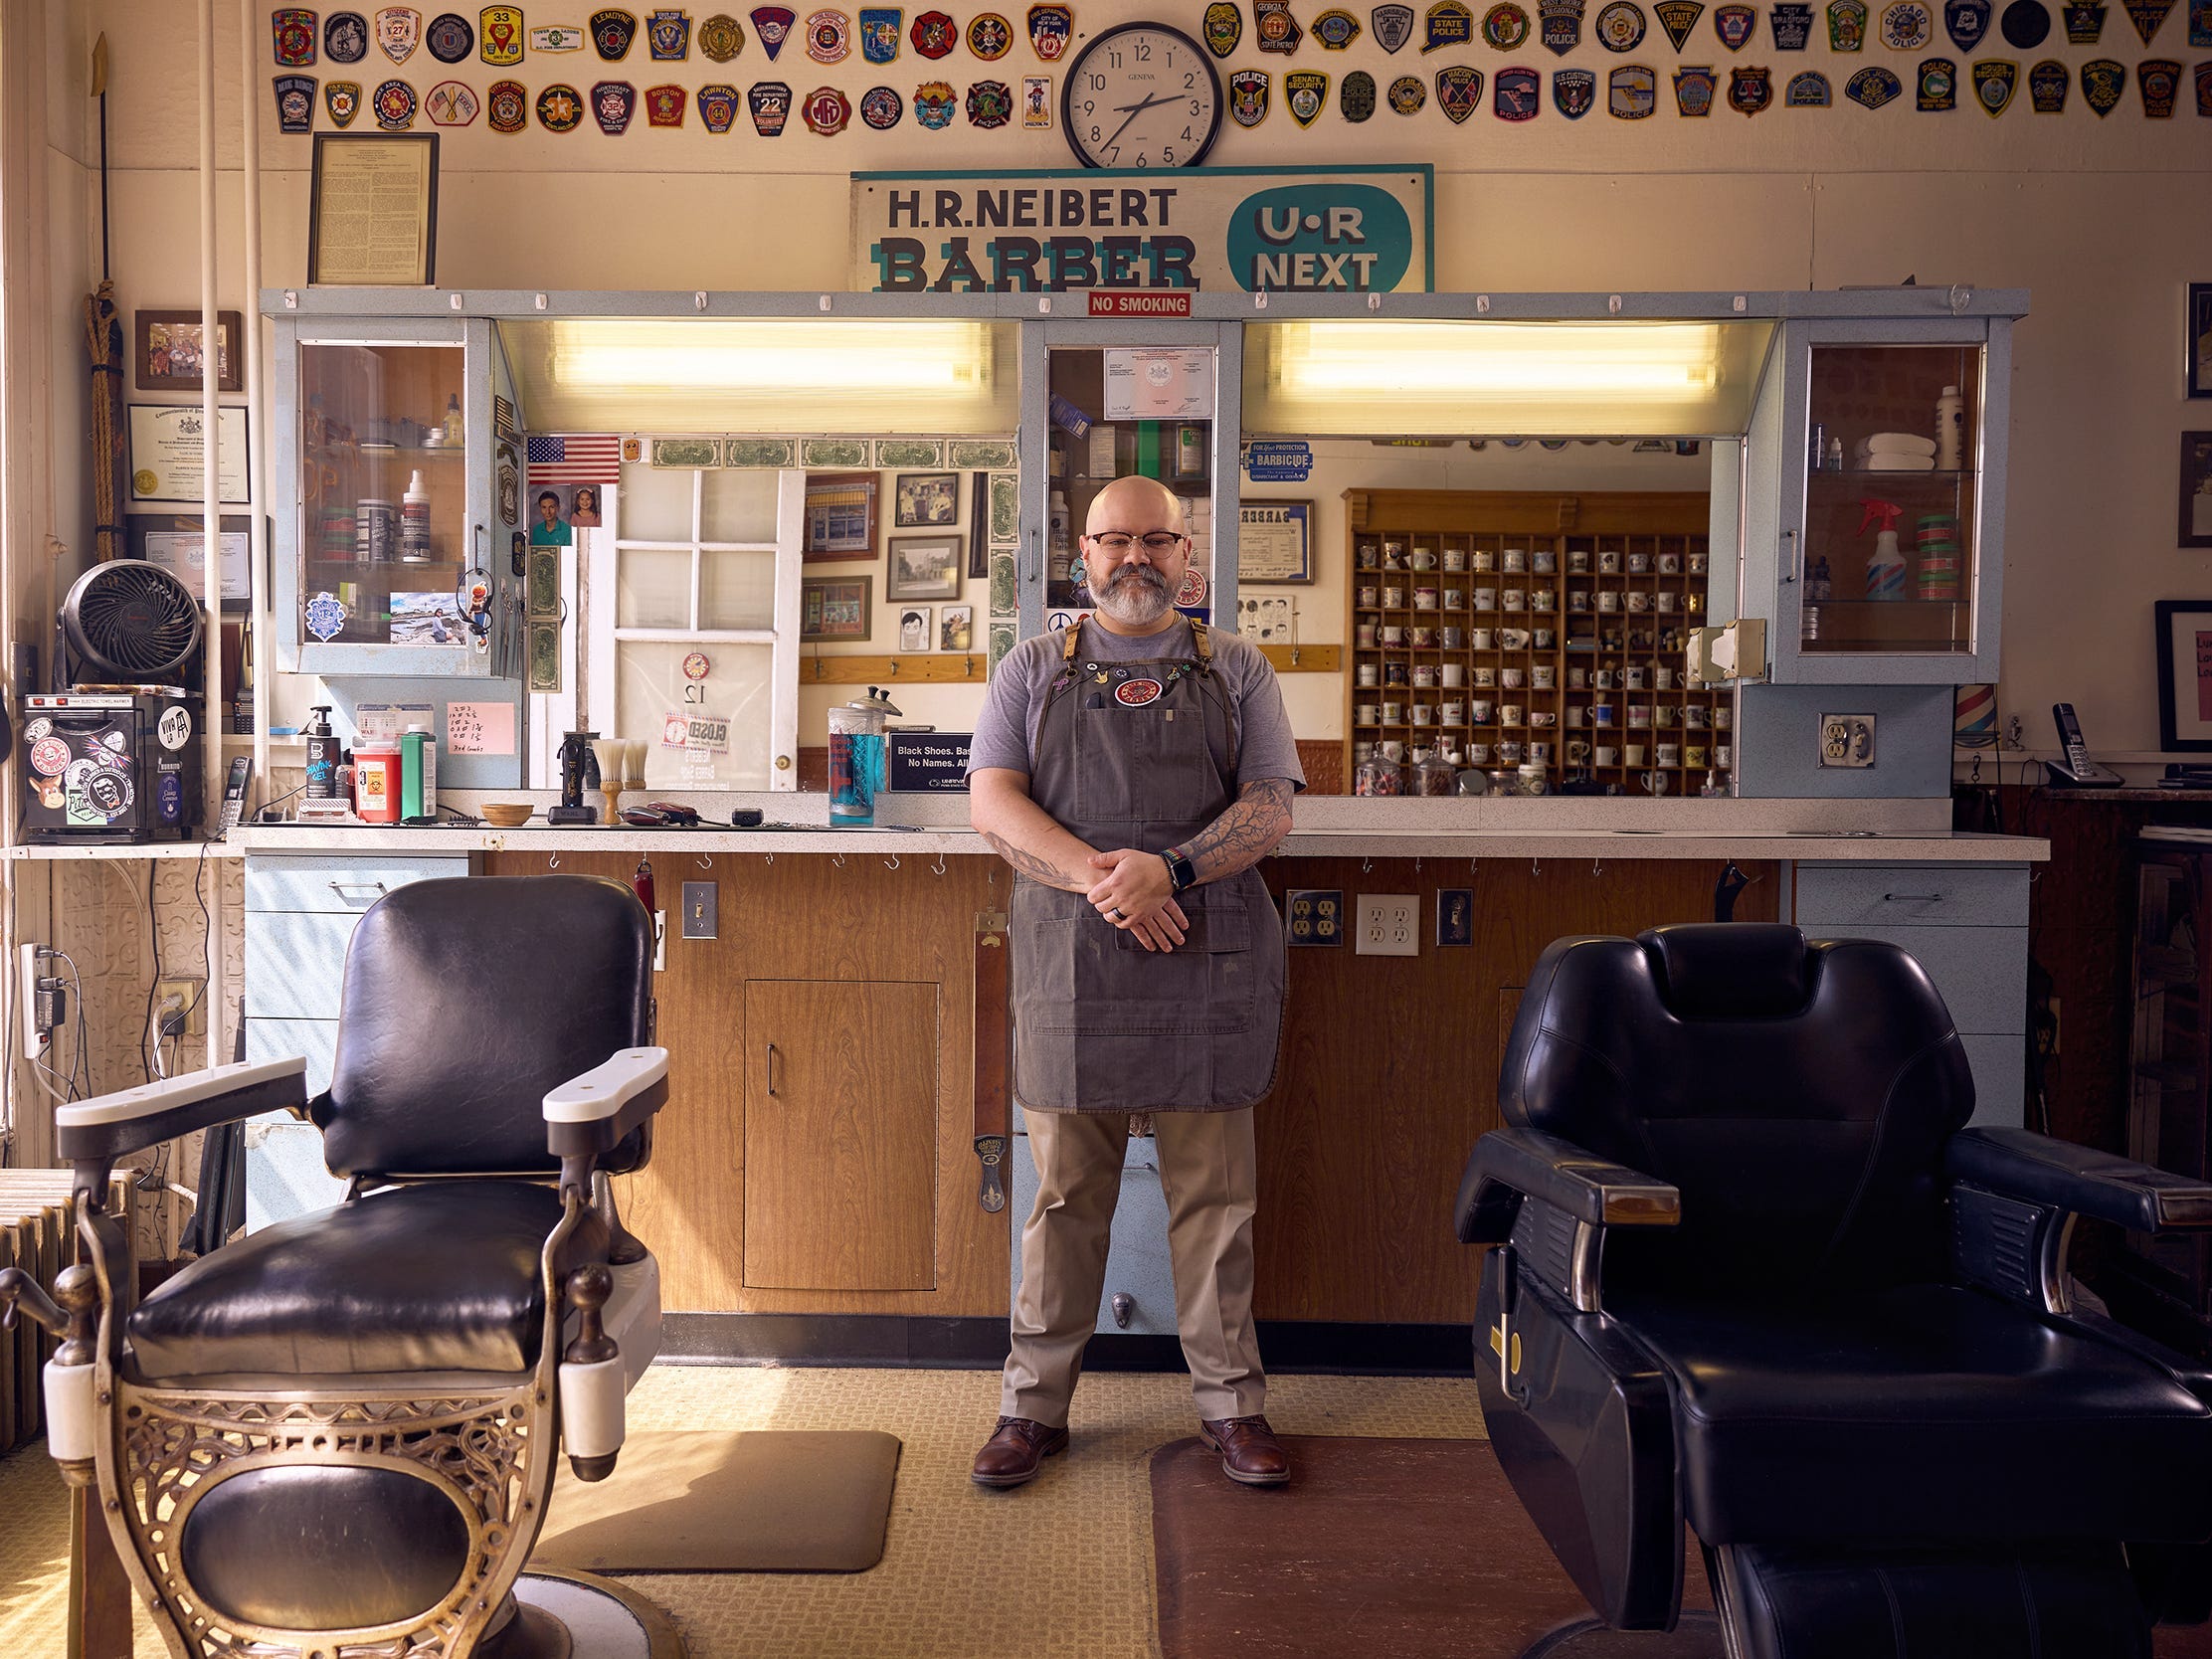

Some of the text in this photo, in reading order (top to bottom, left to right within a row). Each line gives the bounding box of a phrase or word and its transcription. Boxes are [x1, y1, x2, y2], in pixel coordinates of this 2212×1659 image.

[1257, 3, 1281, 12] GEORGIA
[1376, 8, 1410, 19] HARRISBURG
[1544, 7, 1577, 16] REGIONAL
[493, 13, 509, 22] 33
[597, 12, 632, 25] LEMOYNE
[1885, 5, 1928, 26] CHICAGO
[1545, 34, 1576, 45] POLICE
[1887, 31, 1927, 48] POLICE
[1109, 52, 1122, 68] 11
[1134, 45, 1151, 61] 12
[1167, 52, 1172, 68] 1
[1922, 62, 1953, 74] POLICE
[2085, 63, 2122, 76] ARLINGTON
[1089, 75, 1106, 91] 10
[1185, 73, 1195, 89] 2
[1231, 71, 1268, 87] POLICE
[1854, 71, 1871, 85] SAN
[375, 87, 385, 101] YORK
[489, 84, 502, 94] CITY
[509, 84, 524, 94] YORK
[596, 86, 630, 94] NORTHEAST
[700, 87, 737, 100] LAWNTON
[1345, 89, 1372, 97] POLICE
[546, 96, 574, 121] 33
[760, 97, 781, 112] 22
[1084, 100, 1095, 116] 9
[1190, 100, 1200, 116] 3
[2089, 97, 2116, 107] POLICE
[1499, 110, 1534, 119] POLICE
[1613, 107, 1650, 118] POLICE
[1091, 126, 1101, 142] 8
[1182, 126, 1193, 141] 4
[1111, 146, 1121, 163] 7
[1136, 152, 1147, 168] 6
[1164, 147, 1174, 163] 5
[873, 236, 1202, 293] BARBER
[1258, 253, 1381, 291] NEXT
[1092, 296, 1188, 313] NO SMOKING
[1257, 455, 1309, 466] BARBICIDE
[1178, 592, 1199, 603] ARBER
[161, 717, 176, 735] VIVA
[898, 746, 973, 756] Black Shoes. Bas
[306, 760, 332, 776] SHAVING
[312, 772, 327, 781] GEL
